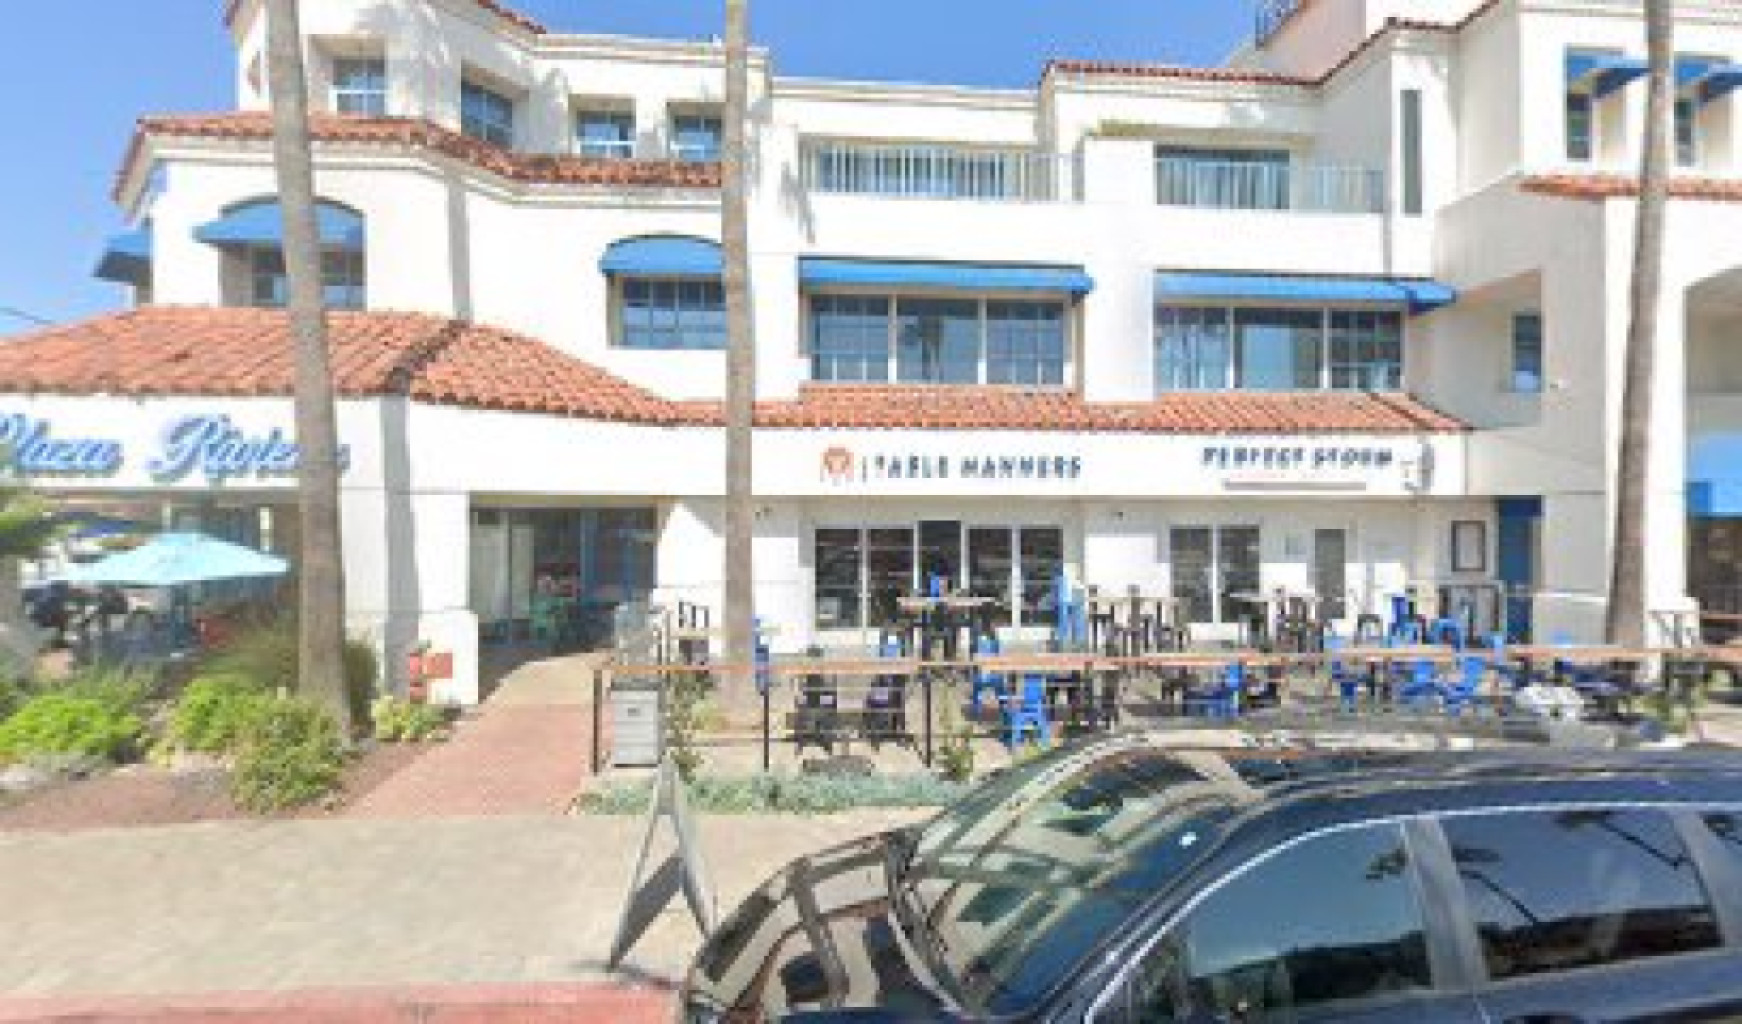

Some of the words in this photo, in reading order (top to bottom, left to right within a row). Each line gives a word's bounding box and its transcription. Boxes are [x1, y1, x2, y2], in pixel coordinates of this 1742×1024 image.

[875, 456, 949, 478] TABLE
[960, 456, 1080, 478] MANNERS
[1203, 447, 1304, 469] PERFECT
[1313, 447, 1393, 469] STORM
